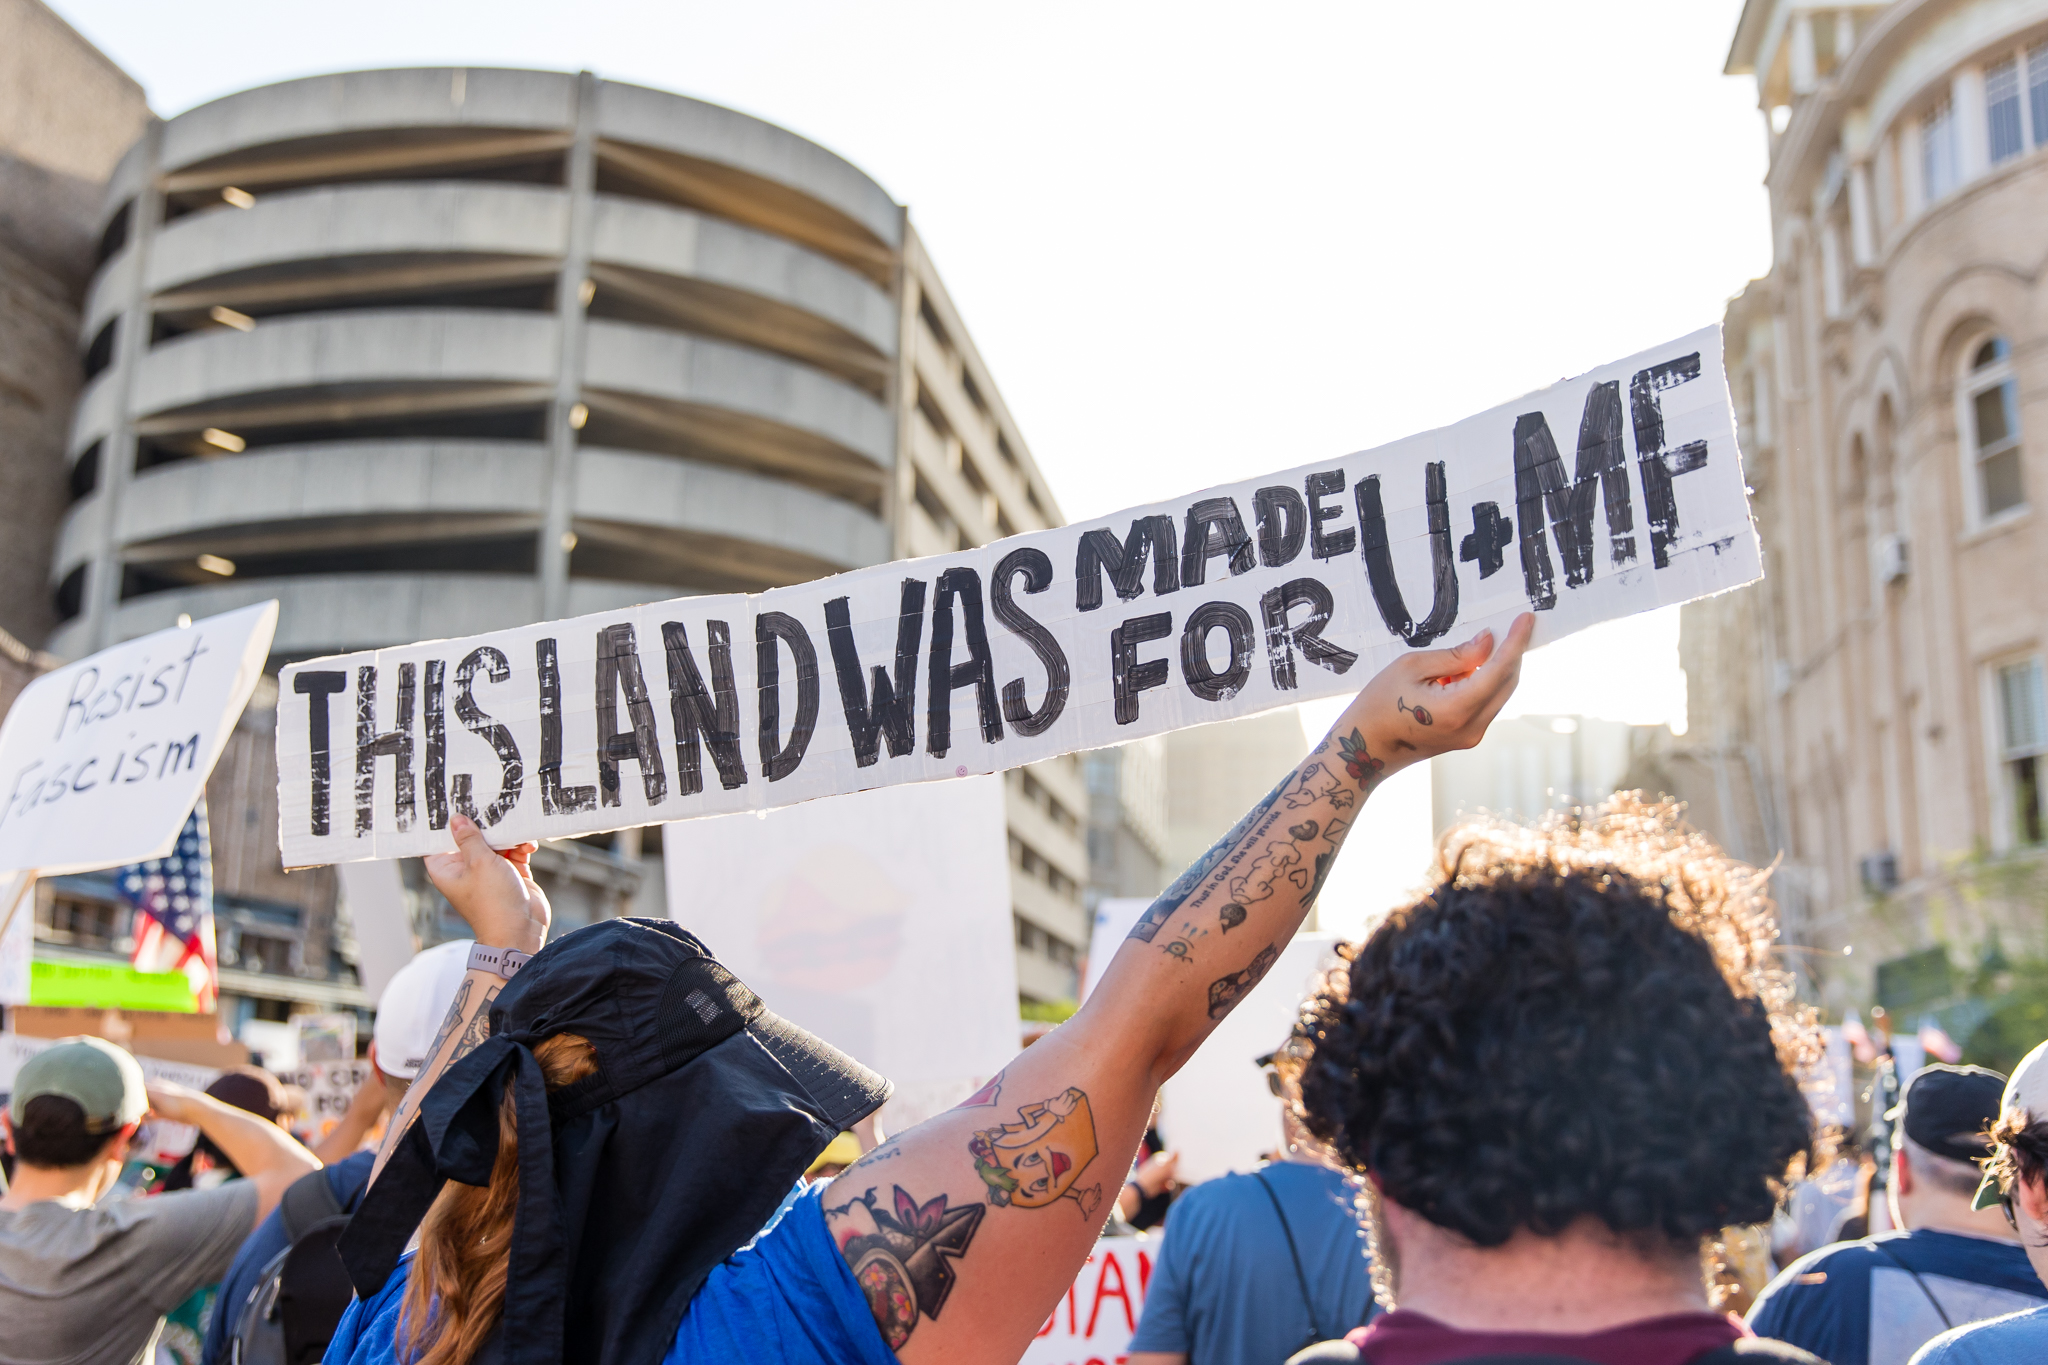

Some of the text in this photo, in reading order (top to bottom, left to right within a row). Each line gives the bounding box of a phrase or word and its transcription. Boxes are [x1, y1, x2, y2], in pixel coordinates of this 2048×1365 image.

[1075, 467, 1357, 612] MADE
[54, 634, 209, 742] Resist
[294, 546, 1071, 838] THIS LAND WAS
[1111, 577, 1360, 726] FOR
[0, 731, 200, 828] Fascism
[1190, 889, 1211, 908] Trust
[1231, 850, 1247, 864] She
[1243, 836, 1259, 850] will
[1256, 811, 1282, 837] provide
